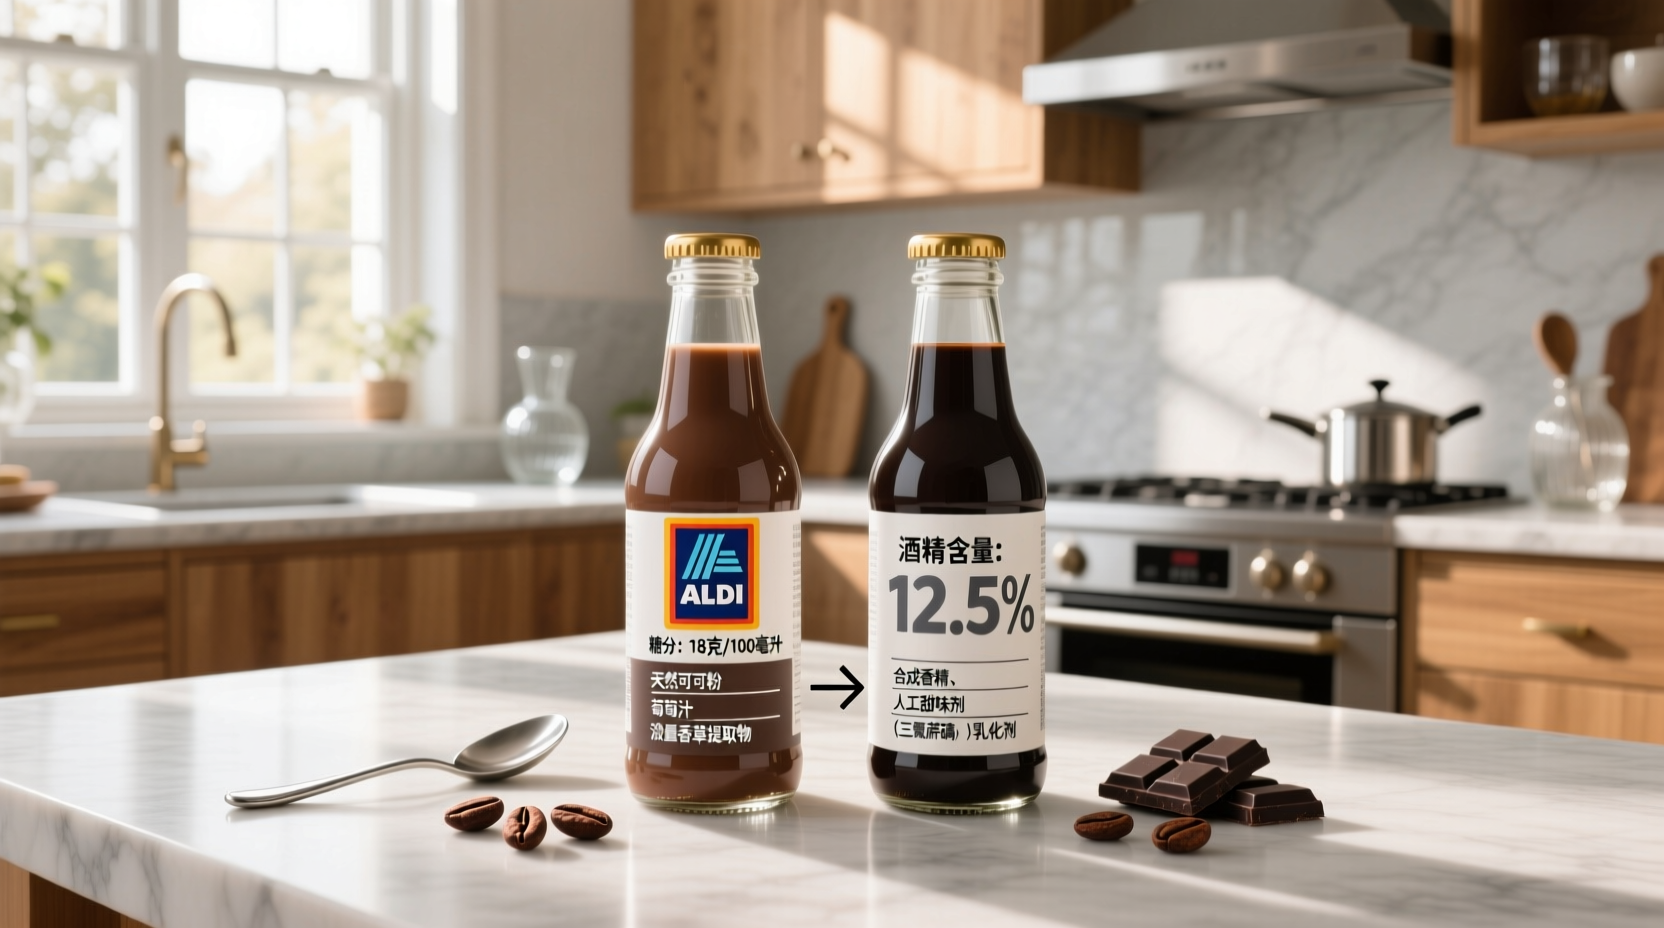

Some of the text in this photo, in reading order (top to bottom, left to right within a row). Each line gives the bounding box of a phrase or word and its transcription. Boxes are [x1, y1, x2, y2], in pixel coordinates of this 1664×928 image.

[680, 584, 743, 605] ALDI
[888, 573, 1035, 636] 12.5%
[650, 671, 722, 691] 天然可可粉
